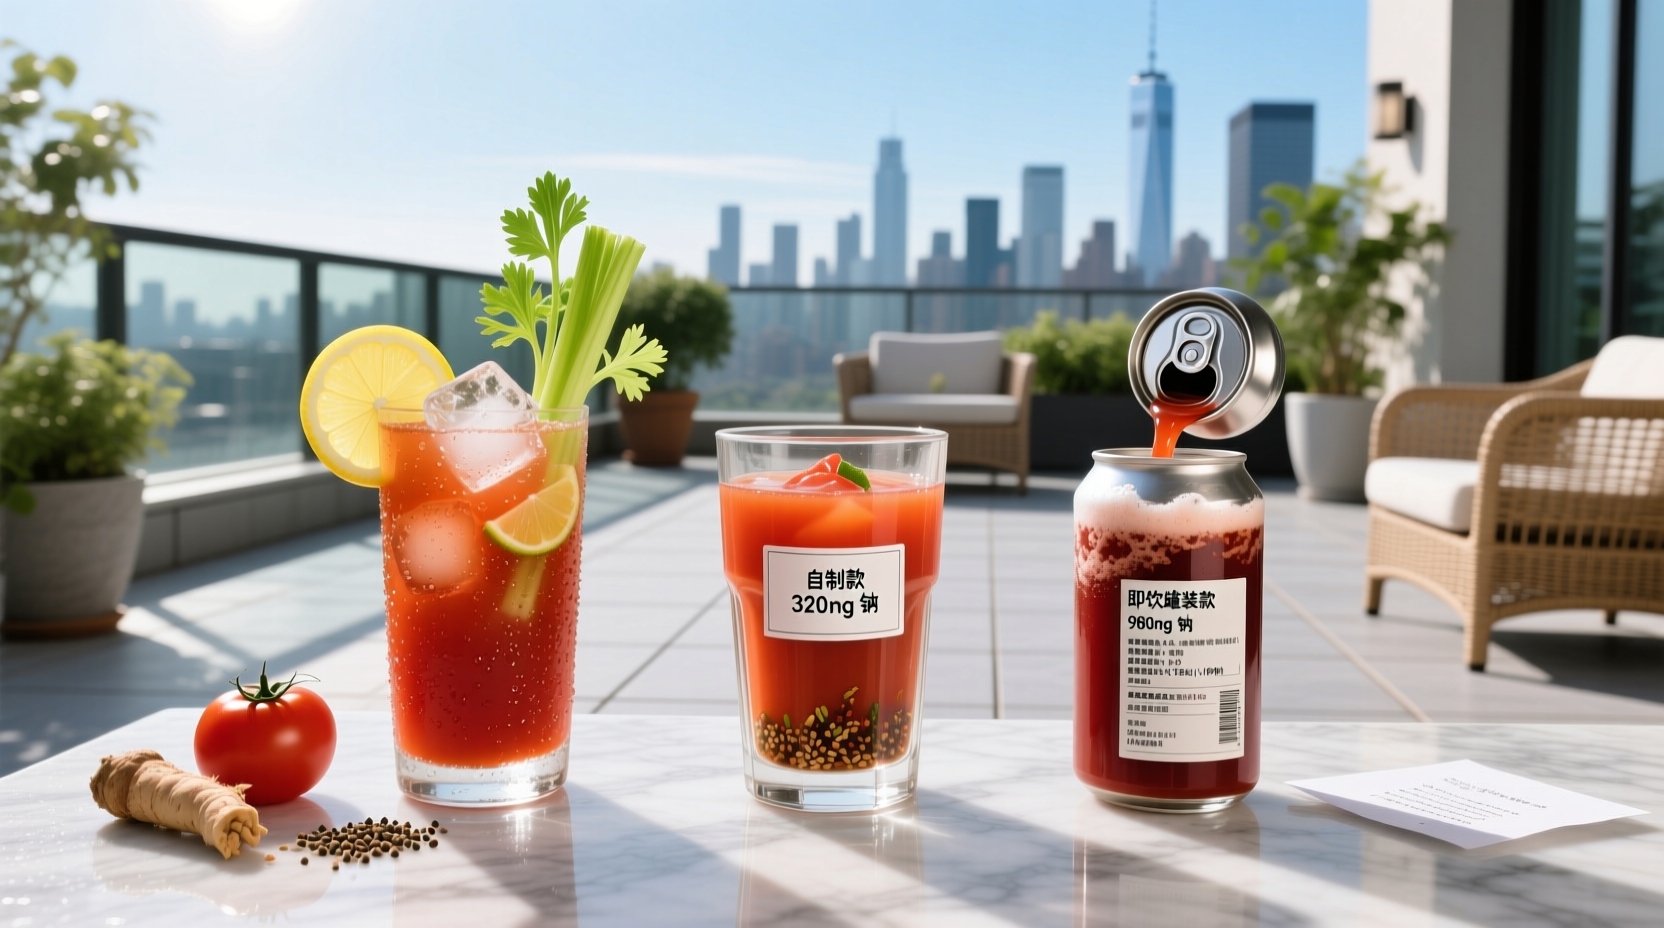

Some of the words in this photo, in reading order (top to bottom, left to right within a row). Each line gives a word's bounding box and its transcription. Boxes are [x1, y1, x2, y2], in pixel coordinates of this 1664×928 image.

[808, 568, 865, 590] 自制款
[791, 594, 854, 619] 320ng
